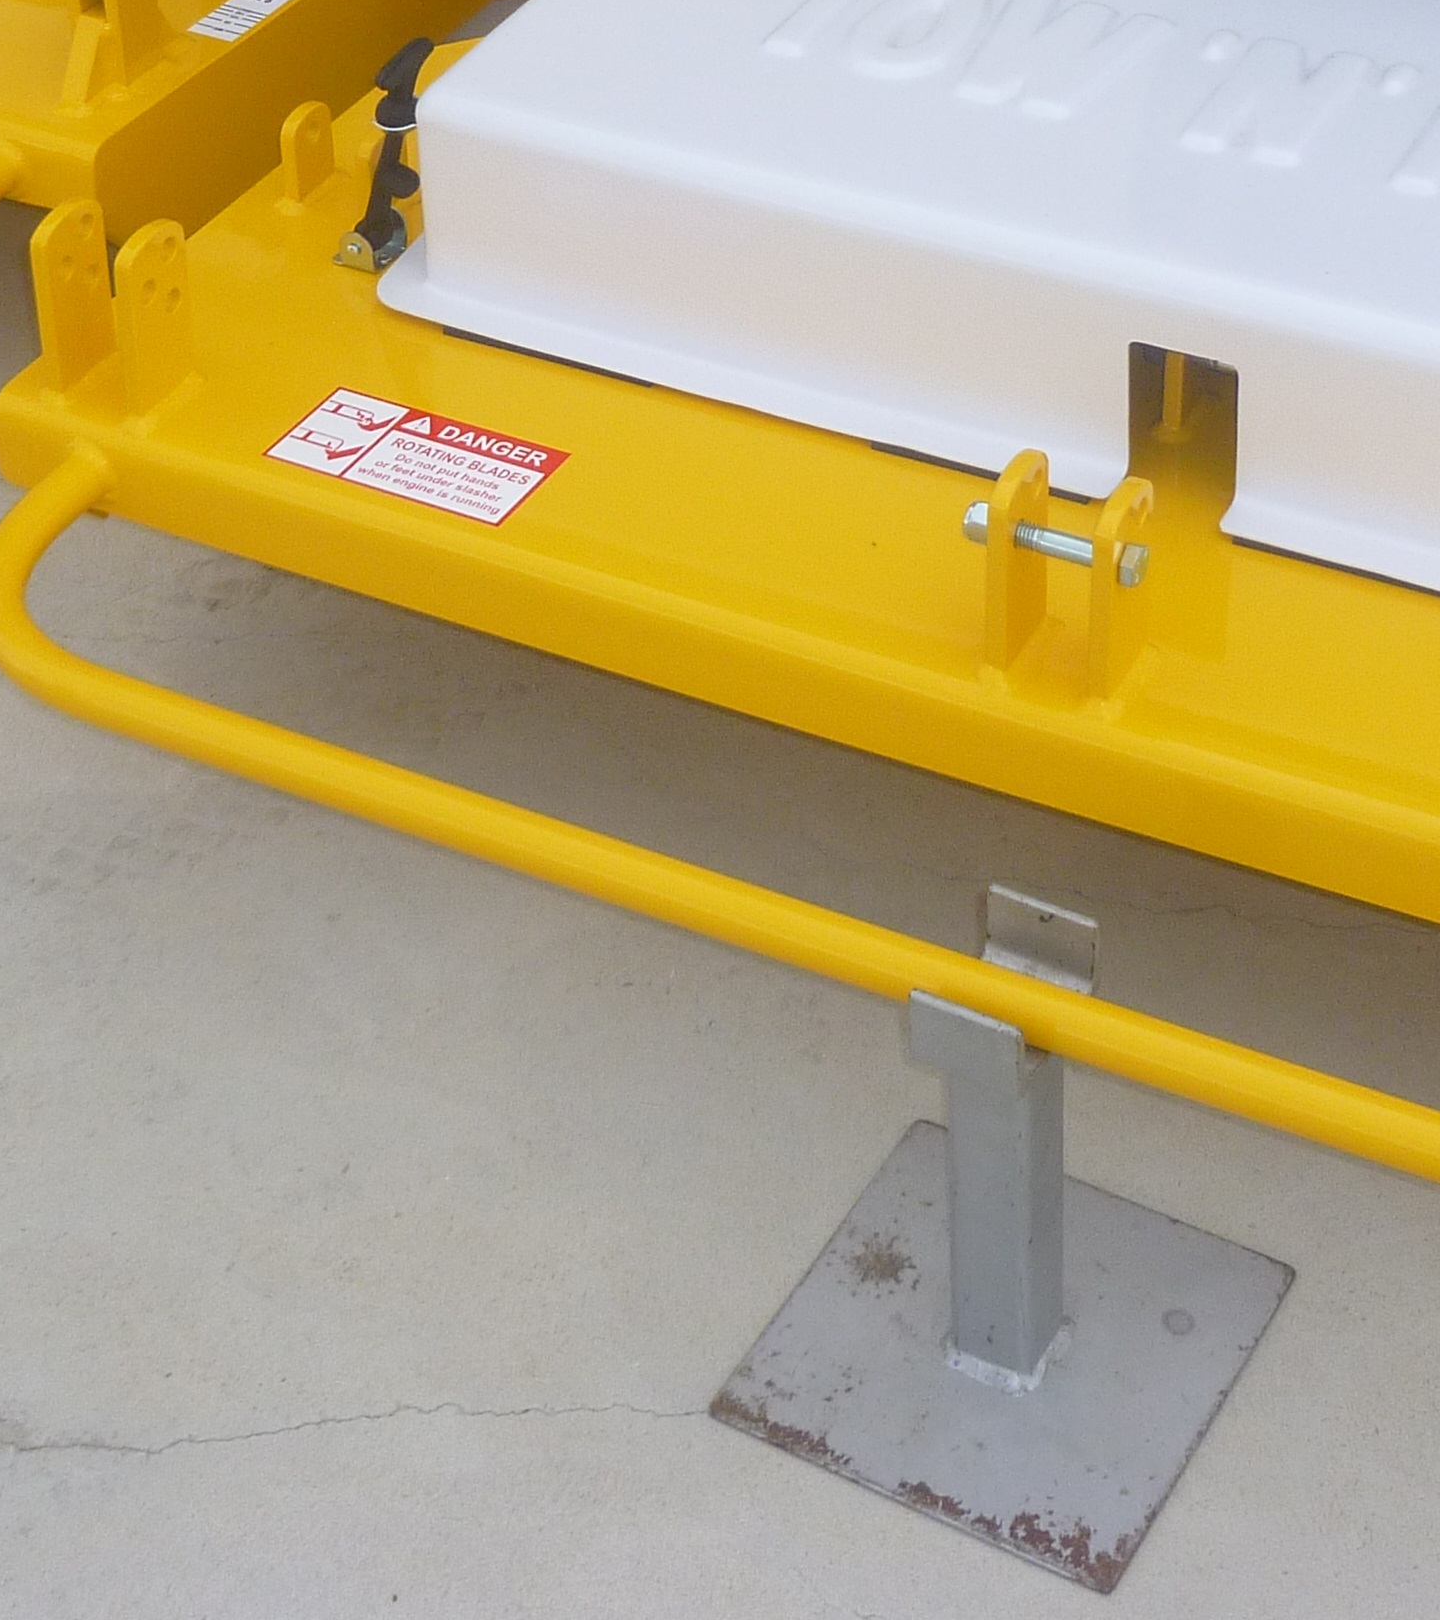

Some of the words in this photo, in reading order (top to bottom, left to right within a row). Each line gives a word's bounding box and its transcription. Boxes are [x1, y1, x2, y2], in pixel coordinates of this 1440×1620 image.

[390, 437, 467, 466] ROTATING
[467, 460, 531, 485] BLADES
[437, 425, 548, 467] DANGER
[358, 466, 390, 482] when
[392, 477, 435, 495] engine
[437, 489, 449, 499] is
[450, 495, 501, 516] running
[375, 460, 390, 468] or
[390, 464, 416, 477] feet
[416, 471, 454, 488] under
[455, 483, 503, 503] slasher
[395, 453, 411, 464] Do
[415, 459, 435, 471] not
[437, 466, 459, 478] put
[461, 472, 499, 491] hands
